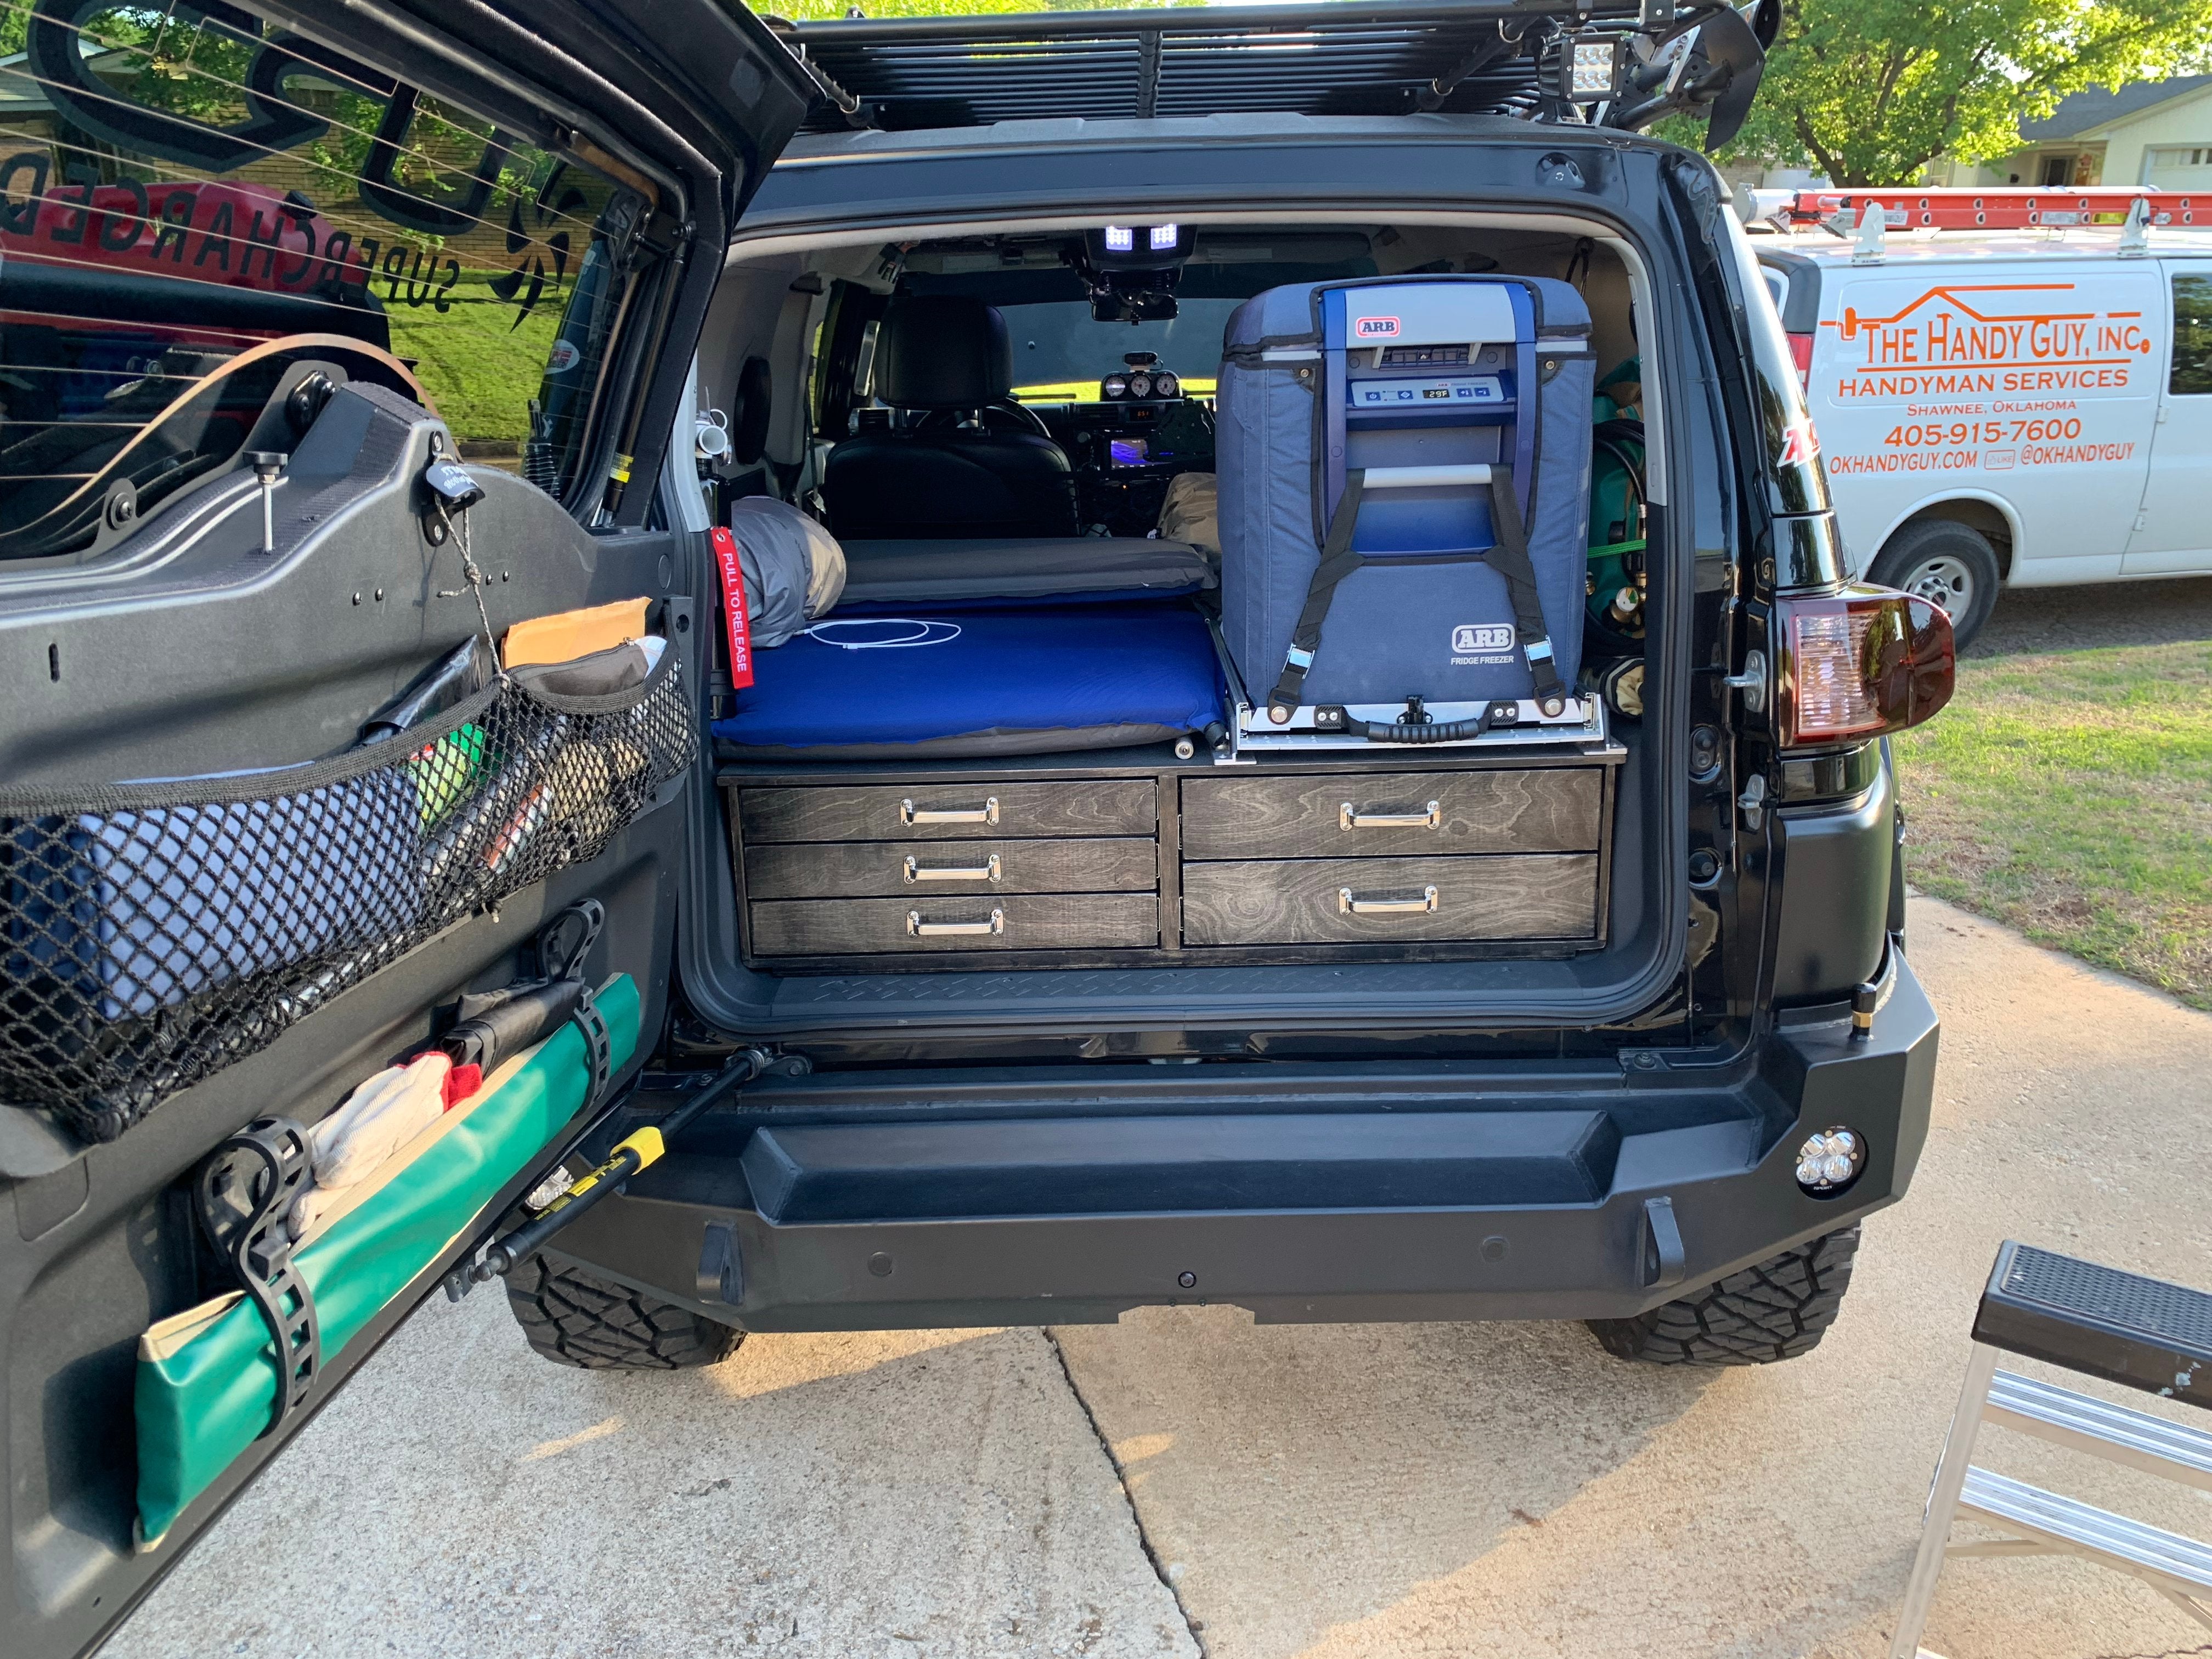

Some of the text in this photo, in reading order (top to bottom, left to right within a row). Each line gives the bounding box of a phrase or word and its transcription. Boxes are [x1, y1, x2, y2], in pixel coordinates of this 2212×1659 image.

[1362, 321, 1395, 332] ARB
[1861, 324, 1918, 364] THE
[1926, 313, 2024, 362] HANDY
[2030, 319, 2090, 360] GUY,
[1838, 369, 2129, 397] HANDYMAN SERVICES
[1907, 400, 2077, 416] SHAWNEE, OKLAHOMA
[1884, 417, 2081, 447] 405-915-7600
[1830, 442, 2135, 474] OKHANDYGUY.COM LIKE @OKHANDYGUY
[722, 552, 747, 673] PULL TO RELEASE
[1457, 629, 1509, 648] ARB
[1451, 655, 1514, 665] FRIDGE FREEZER
